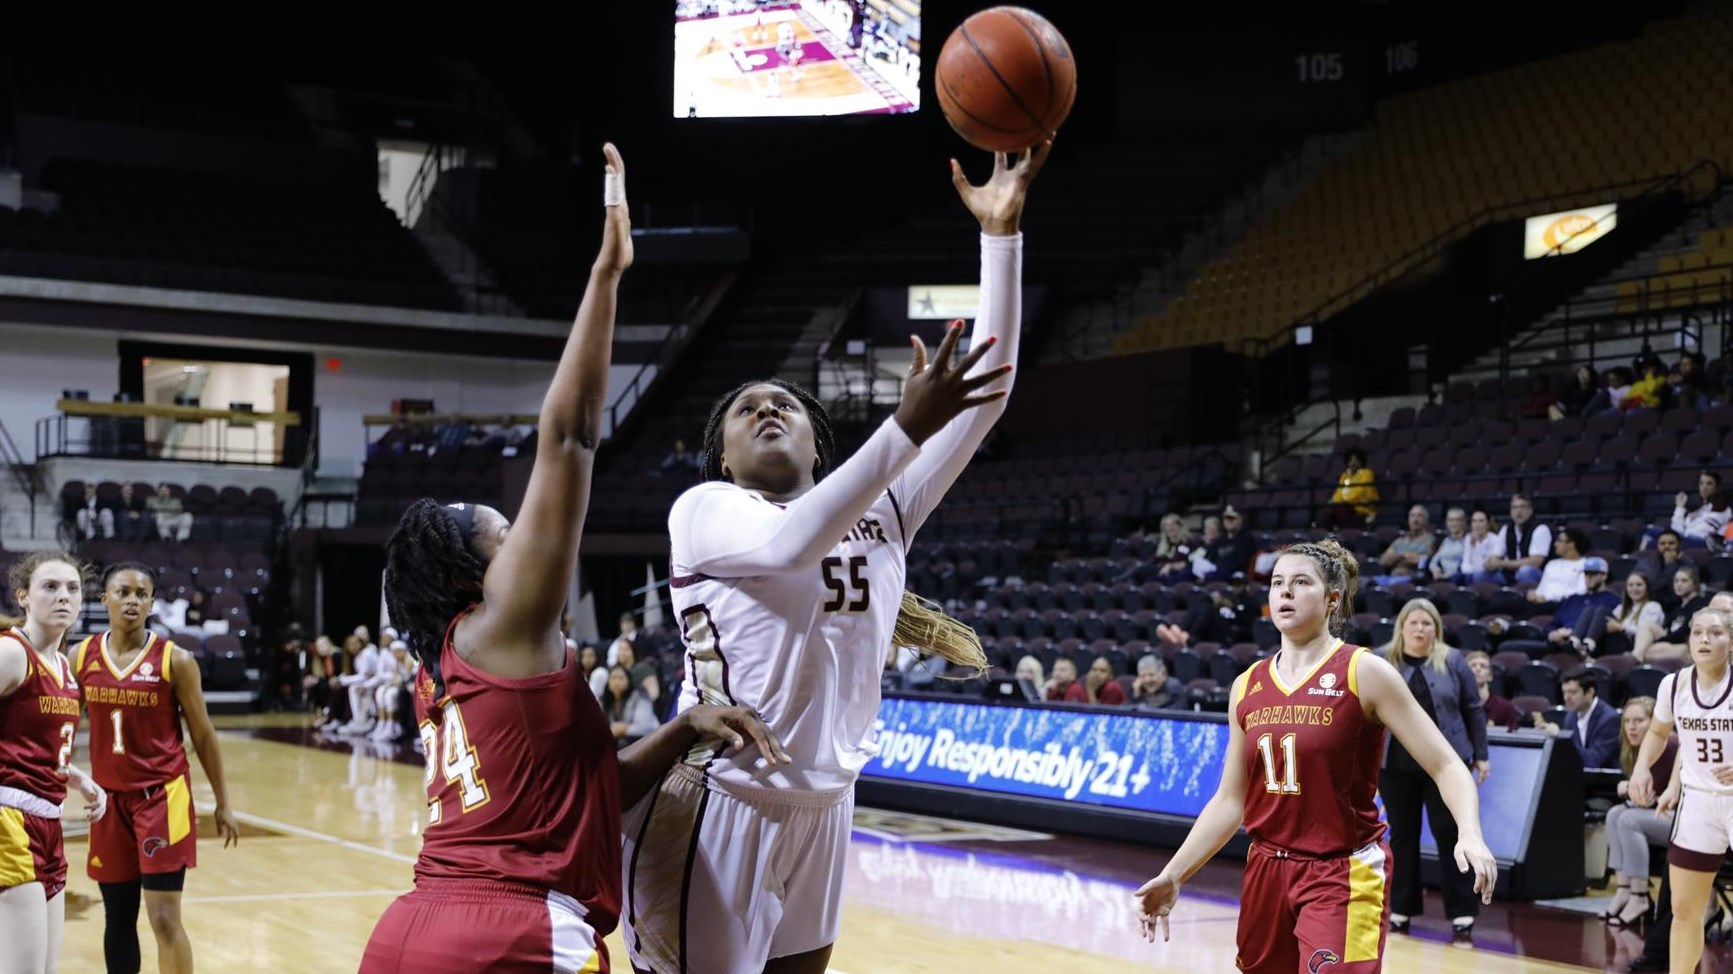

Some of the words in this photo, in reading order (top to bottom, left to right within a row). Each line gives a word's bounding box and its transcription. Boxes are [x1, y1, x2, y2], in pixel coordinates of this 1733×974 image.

[1295, 53, 1343, 81] 105
[1385, 41, 1418, 74] 106
[821, 556, 870, 612] 55
[1307, 687, 1324, 696] SUN
[1325, 687, 1344, 697] BELT
[110, 708, 125, 755] 1
[1245, 704, 1334, 731] WARHAWKS
[58, 721, 74, 767] 2
[419, 695, 491, 825] 24
[926, 728, 1095, 800] Responsibly
[1089, 751, 1150, 798] 21+
[1257, 733, 1301, 795] 11
[1696, 738, 1724, 763] 33
